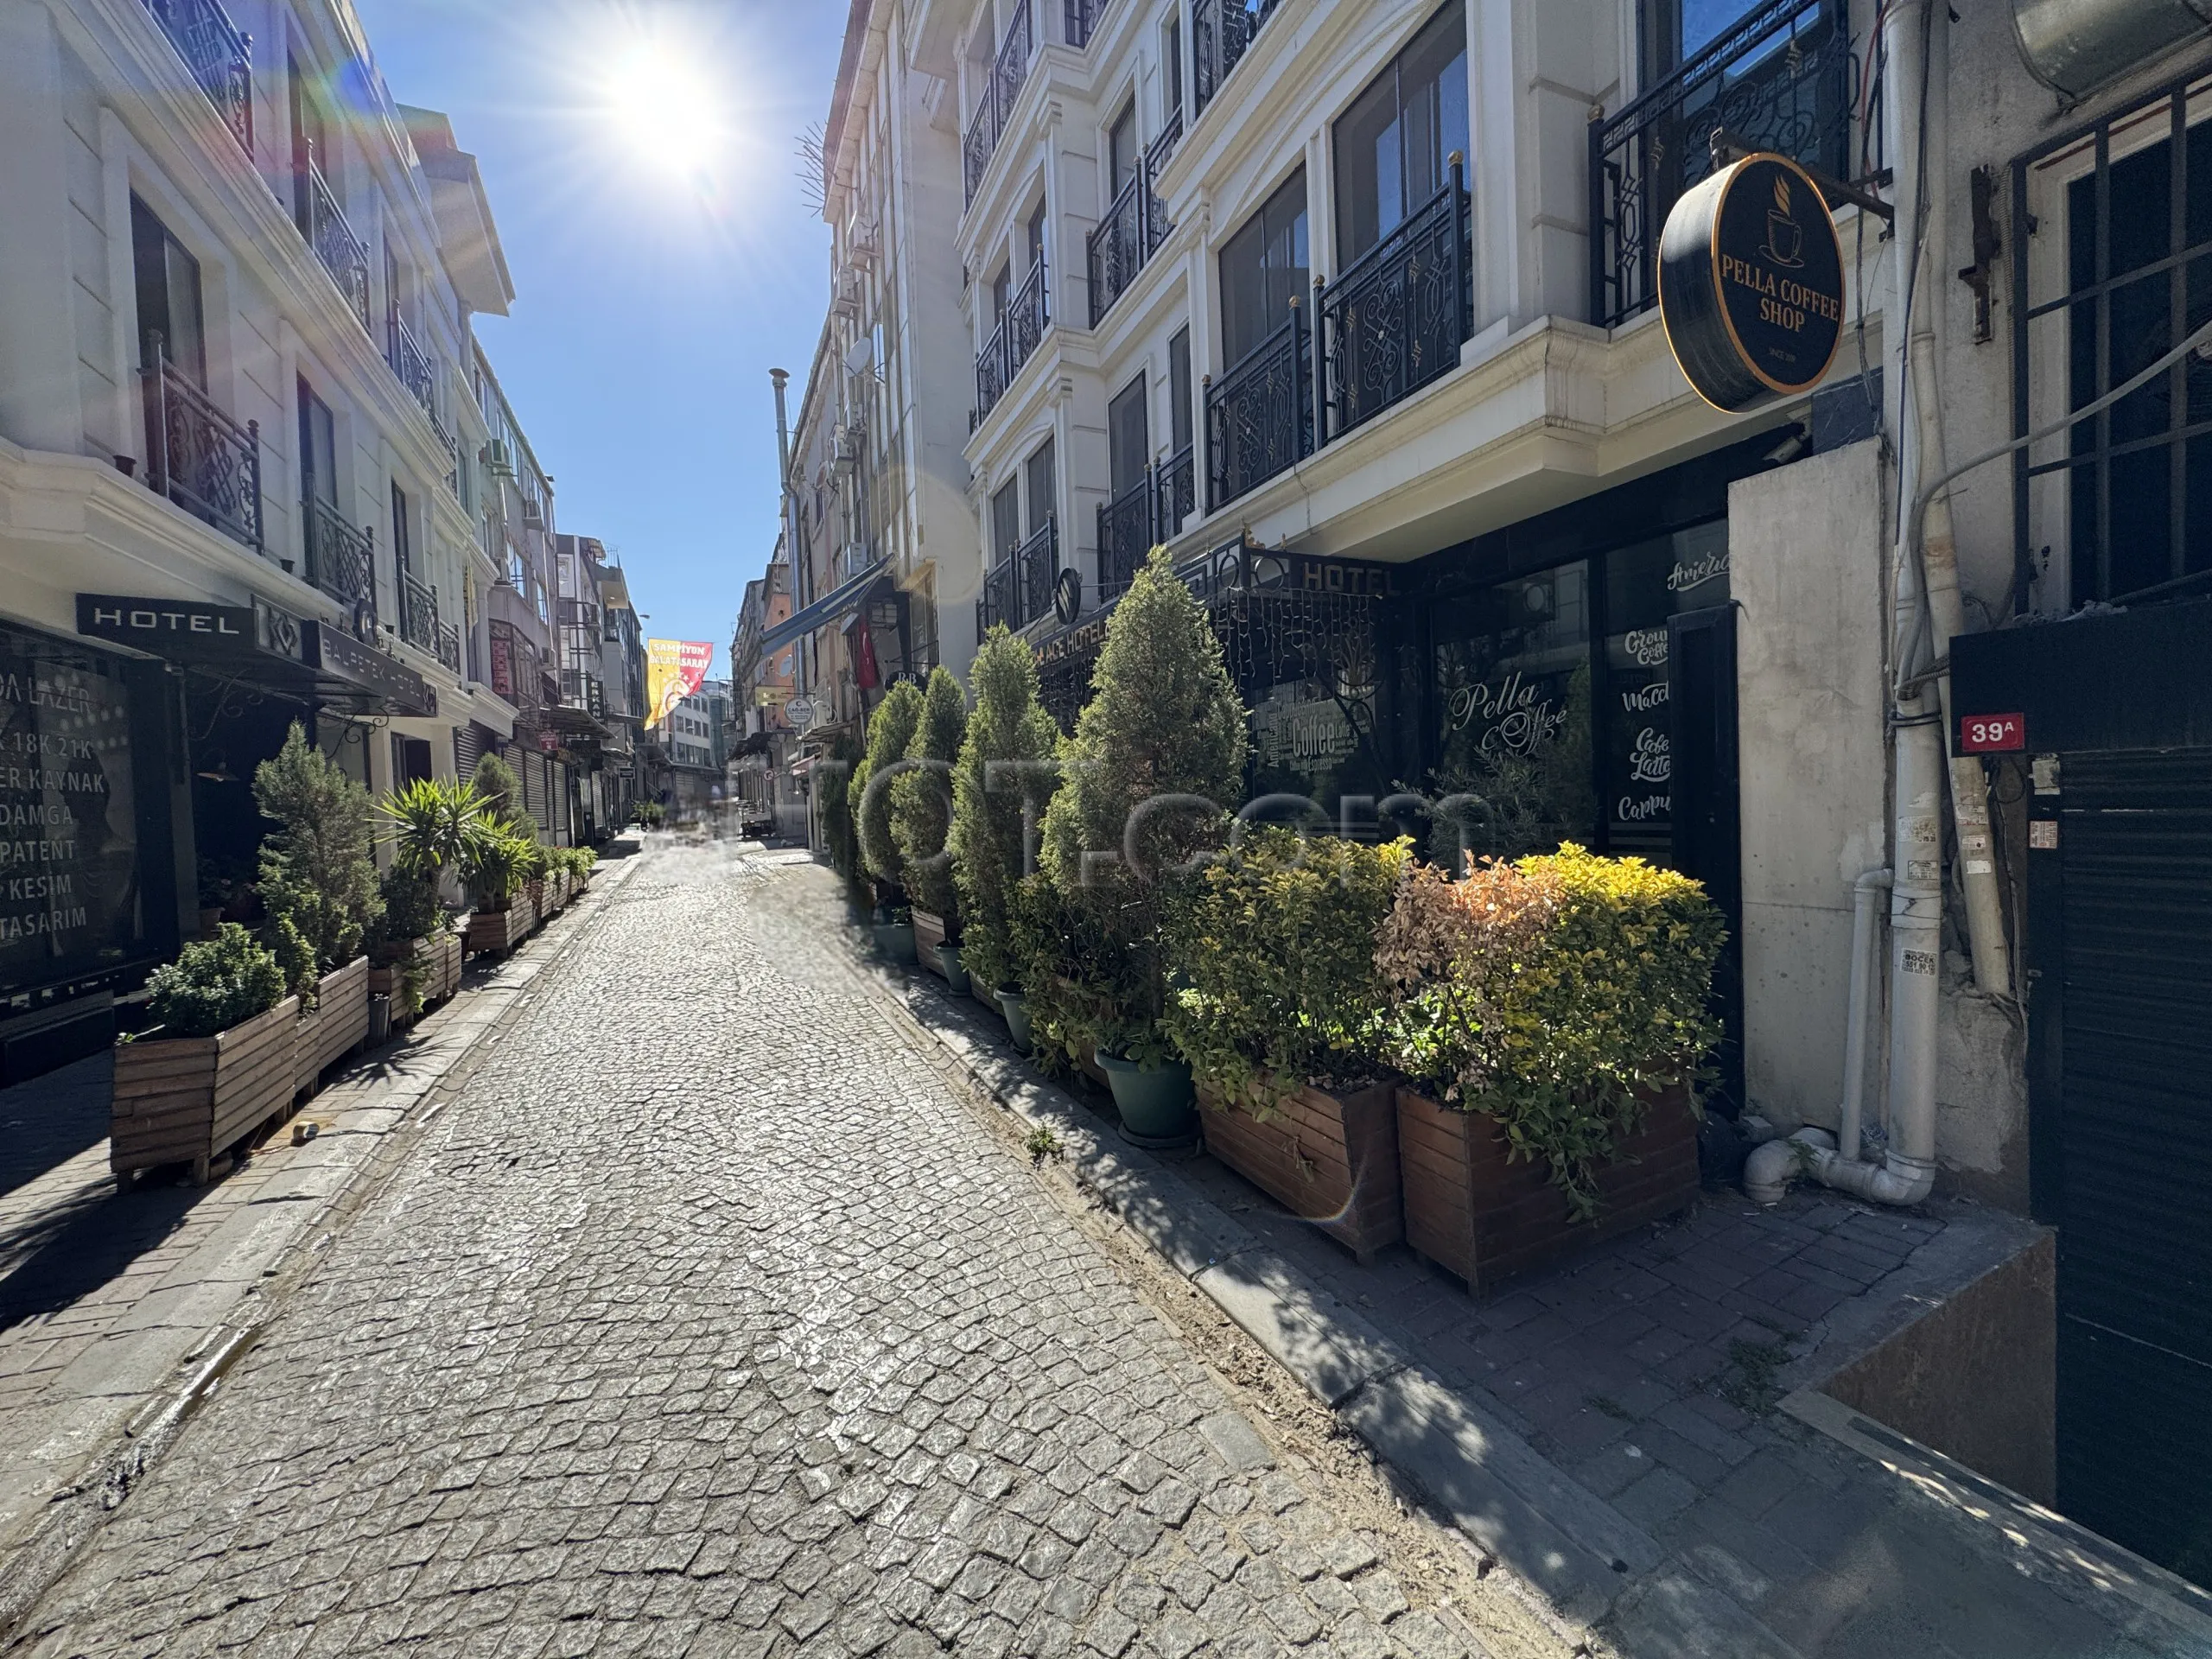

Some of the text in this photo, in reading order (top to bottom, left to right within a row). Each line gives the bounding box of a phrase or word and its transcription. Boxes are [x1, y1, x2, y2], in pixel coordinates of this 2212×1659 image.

[1722, 254, 1839, 322] PELLA COFFEE
[1760, 297, 1805, 333] SHOP
[1305, 563, 1401, 596] HOTEL
[94, 607, 239, 634] HOTEL
[1067, 619, 1104, 654] HOTEL
[323, 639, 386, 682] BALPETEK
[28, 677, 92, 715] LAZER
[1448, 671, 1539, 731] Pella
[14, 731, 51, 755] 18K
[58, 736, 92, 760] 21K
[1268, 713, 1280, 768] Americano
[1292, 715, 1335, 757] Coffee
[1481, 698, 1567, 759] Coffee
[29, 768, 105, 792] KAYNAK
[1307, 755, 1332, 772] Espresso
[0, 804, 73, 826] DAMGA
[0, 839, 75, 864] PATENT
[0, 907, 86, 940] TASARIM
